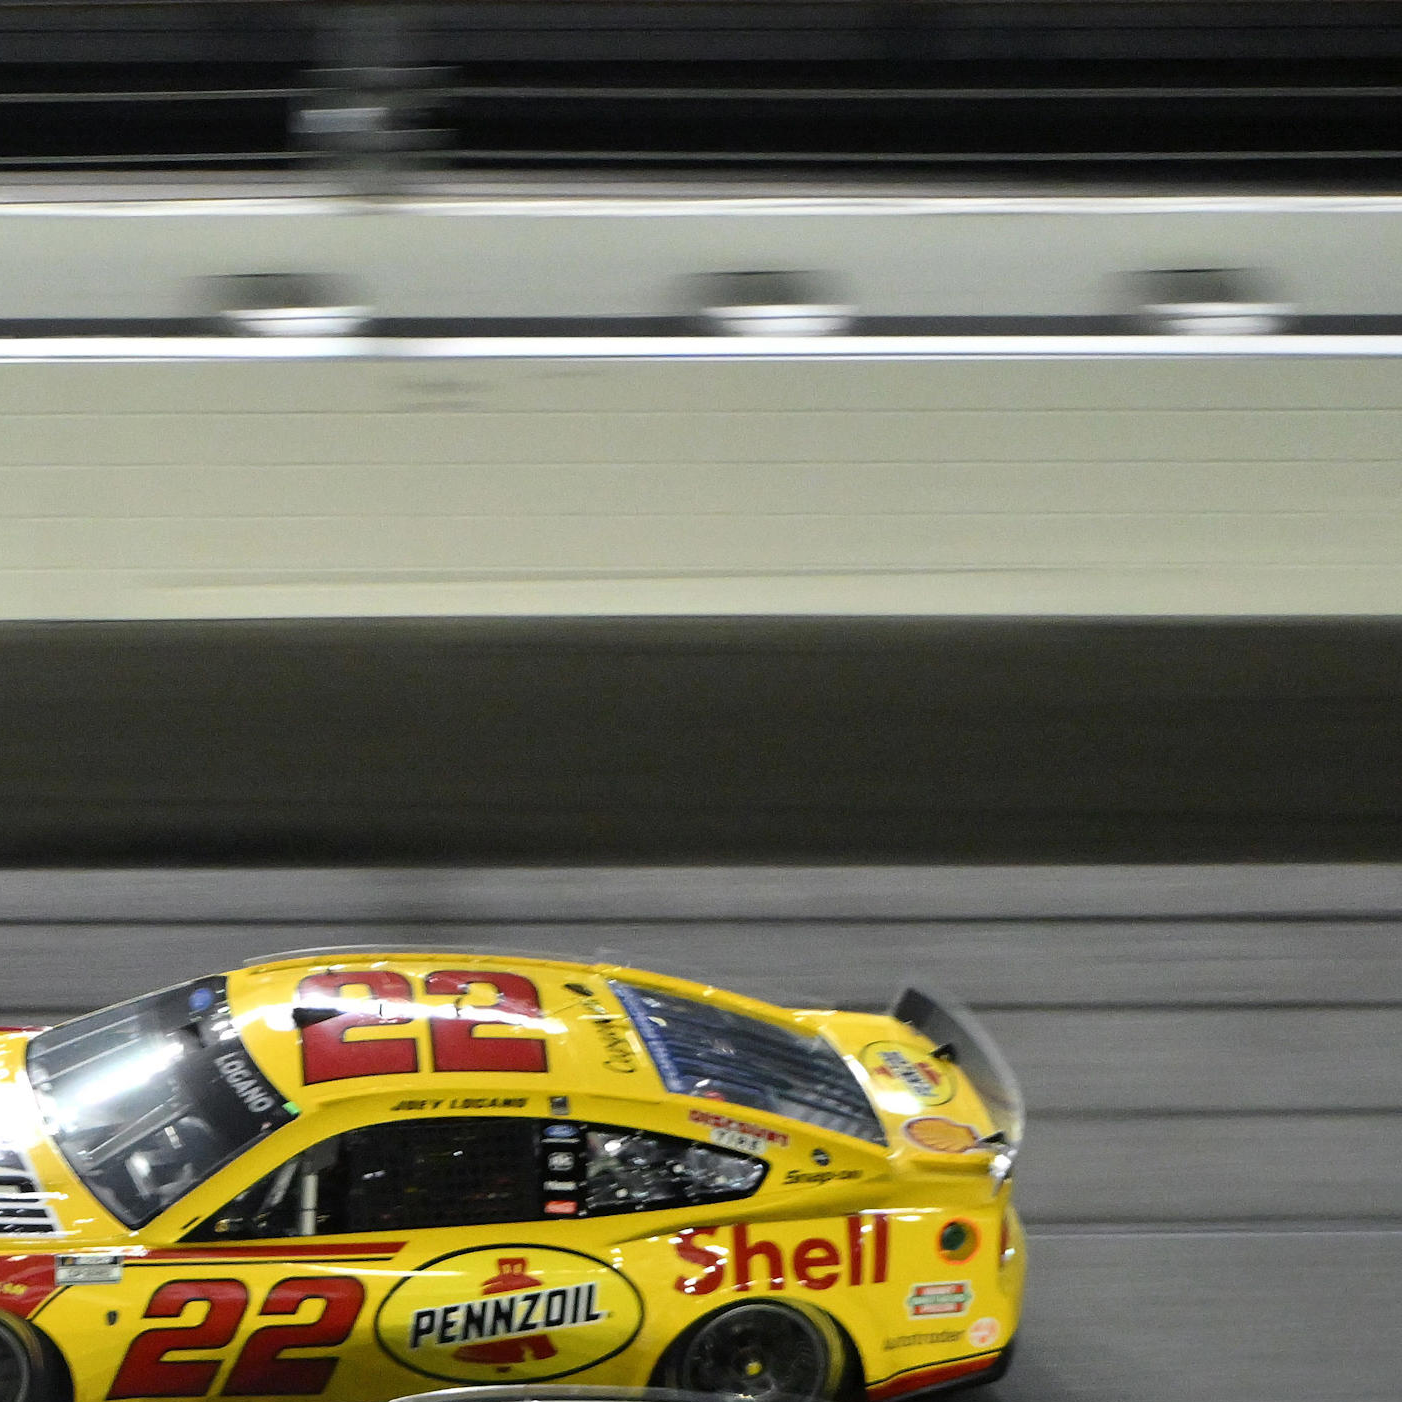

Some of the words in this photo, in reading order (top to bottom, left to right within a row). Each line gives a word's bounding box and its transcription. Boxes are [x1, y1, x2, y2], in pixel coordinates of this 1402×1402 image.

[296, 970, 548, 1085] 22
[213, 1054, 273, 1114] LOGANO
[674, 1214, 890, 1296] Shell
[106, 1276, 365, 1400] 22
[410, 1282, 610, 1348] PENNZOIL
